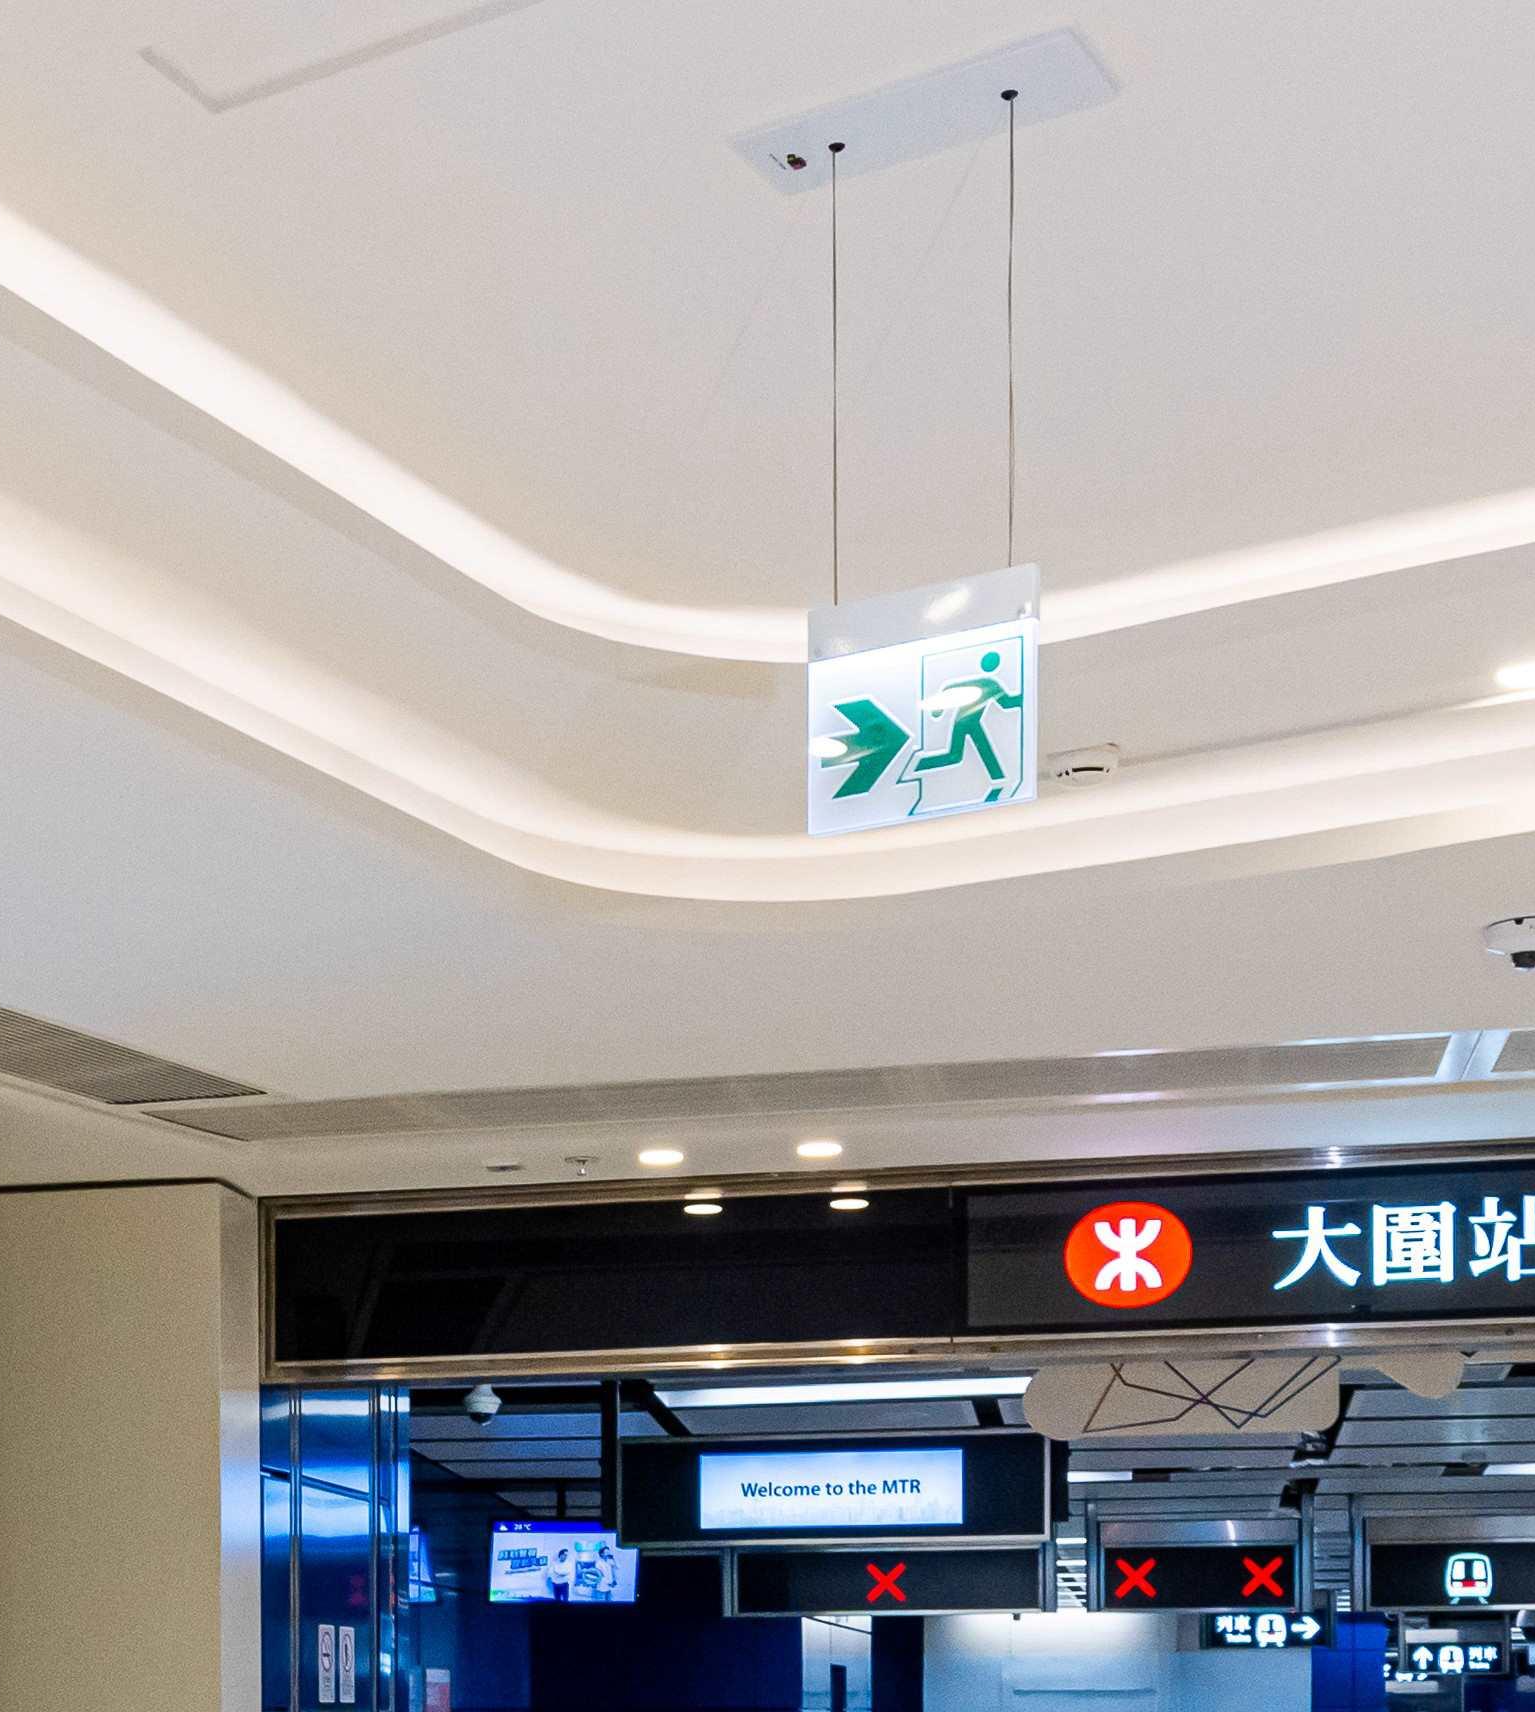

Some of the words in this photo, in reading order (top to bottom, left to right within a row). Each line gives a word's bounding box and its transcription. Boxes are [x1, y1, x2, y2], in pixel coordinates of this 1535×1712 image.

[741, 1481, 821, 1498] Welcome
[826, 1483, 844, 1496] to
[848, 1480, 877, 1496] the
[882, 1478, 921, 1495] MTR
[1216, 1615, 1251, 1632] 列車
